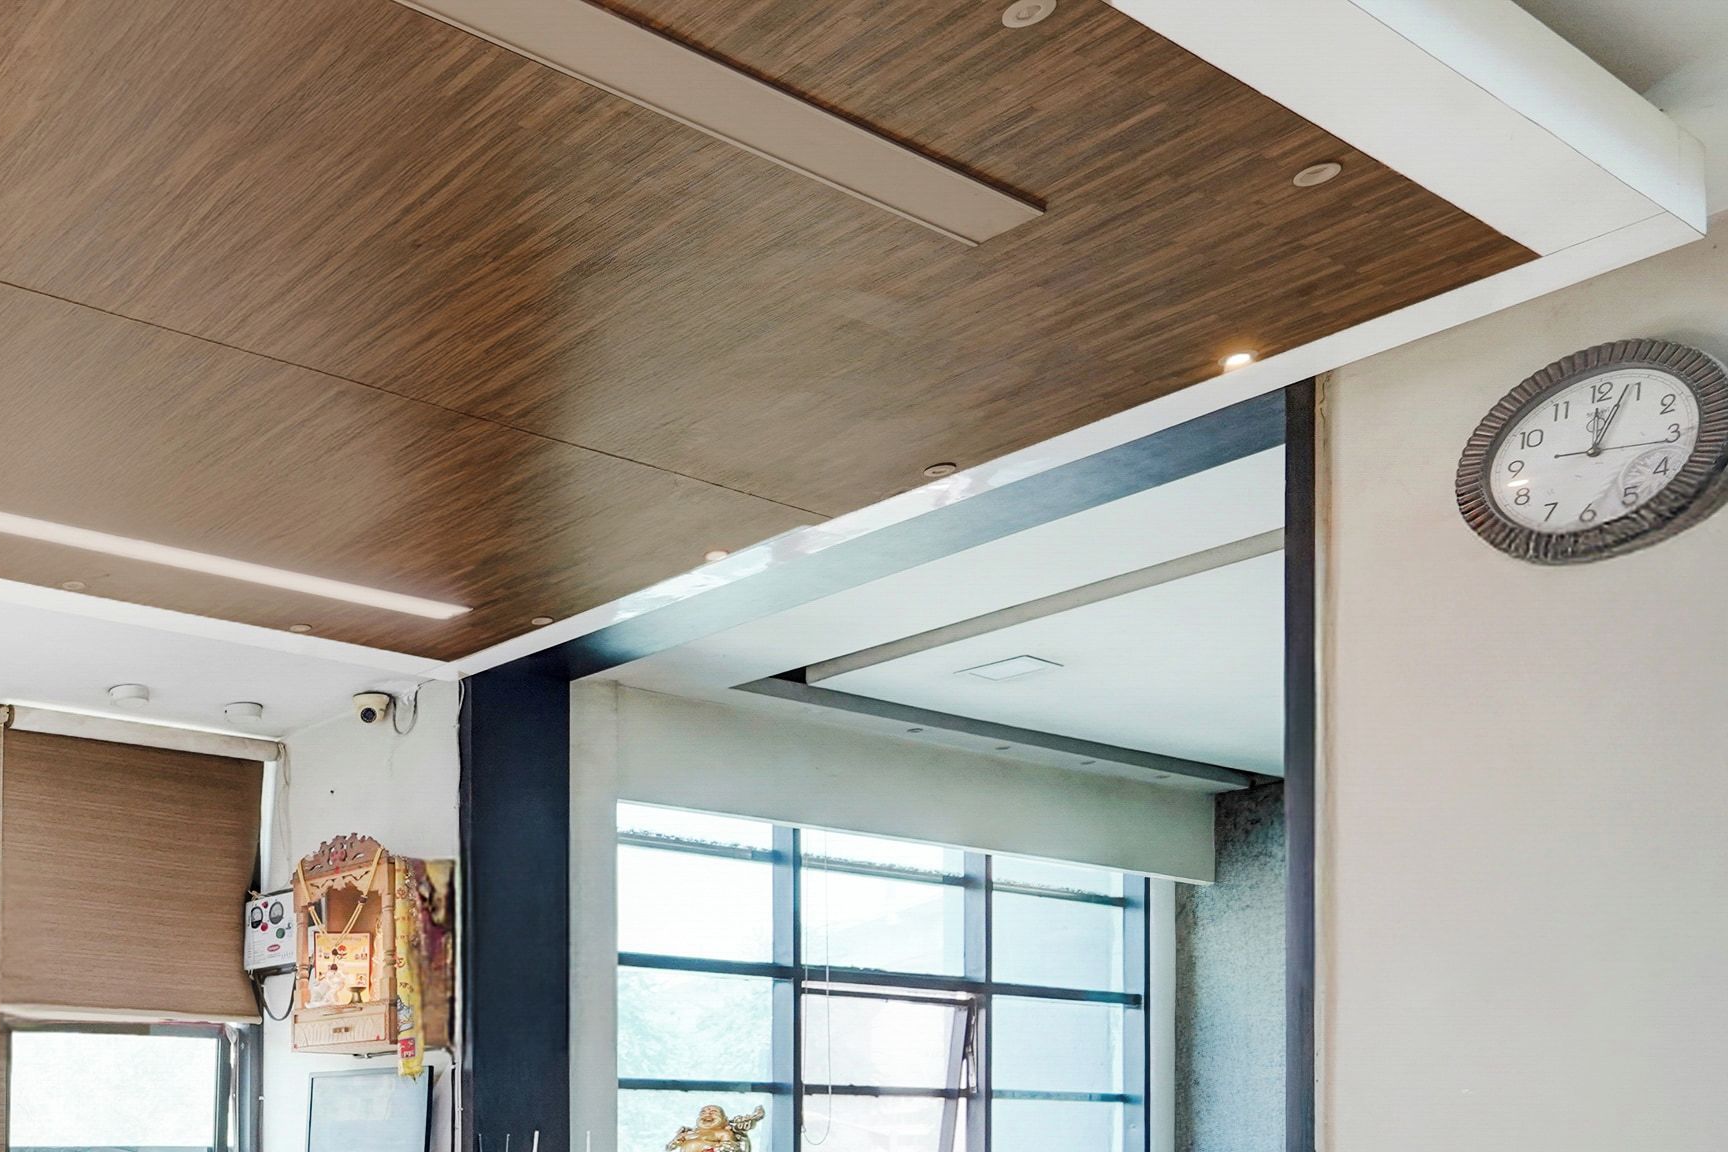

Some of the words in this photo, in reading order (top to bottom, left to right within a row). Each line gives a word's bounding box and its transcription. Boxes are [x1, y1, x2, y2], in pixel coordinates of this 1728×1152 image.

[1590, 381, 1614, 404] 12
[1634, 381, 1642, 402] 1
[1553, 400, 1570, 422] 11
[1659, 393, 1677, 415] 2
[1519, 428, 1544, 450] 10
[1665, 422, 1681, 444] 3
[1507, 460, 1525, 479] 9
[1652, 455, 1670, 476] 4
[1514, 487, 1531, 506] 8
[1621, 485, 1640, 508] 5
[1543, 501, 1559, 522] 7
[1578, 502, 1597, 523] 6
